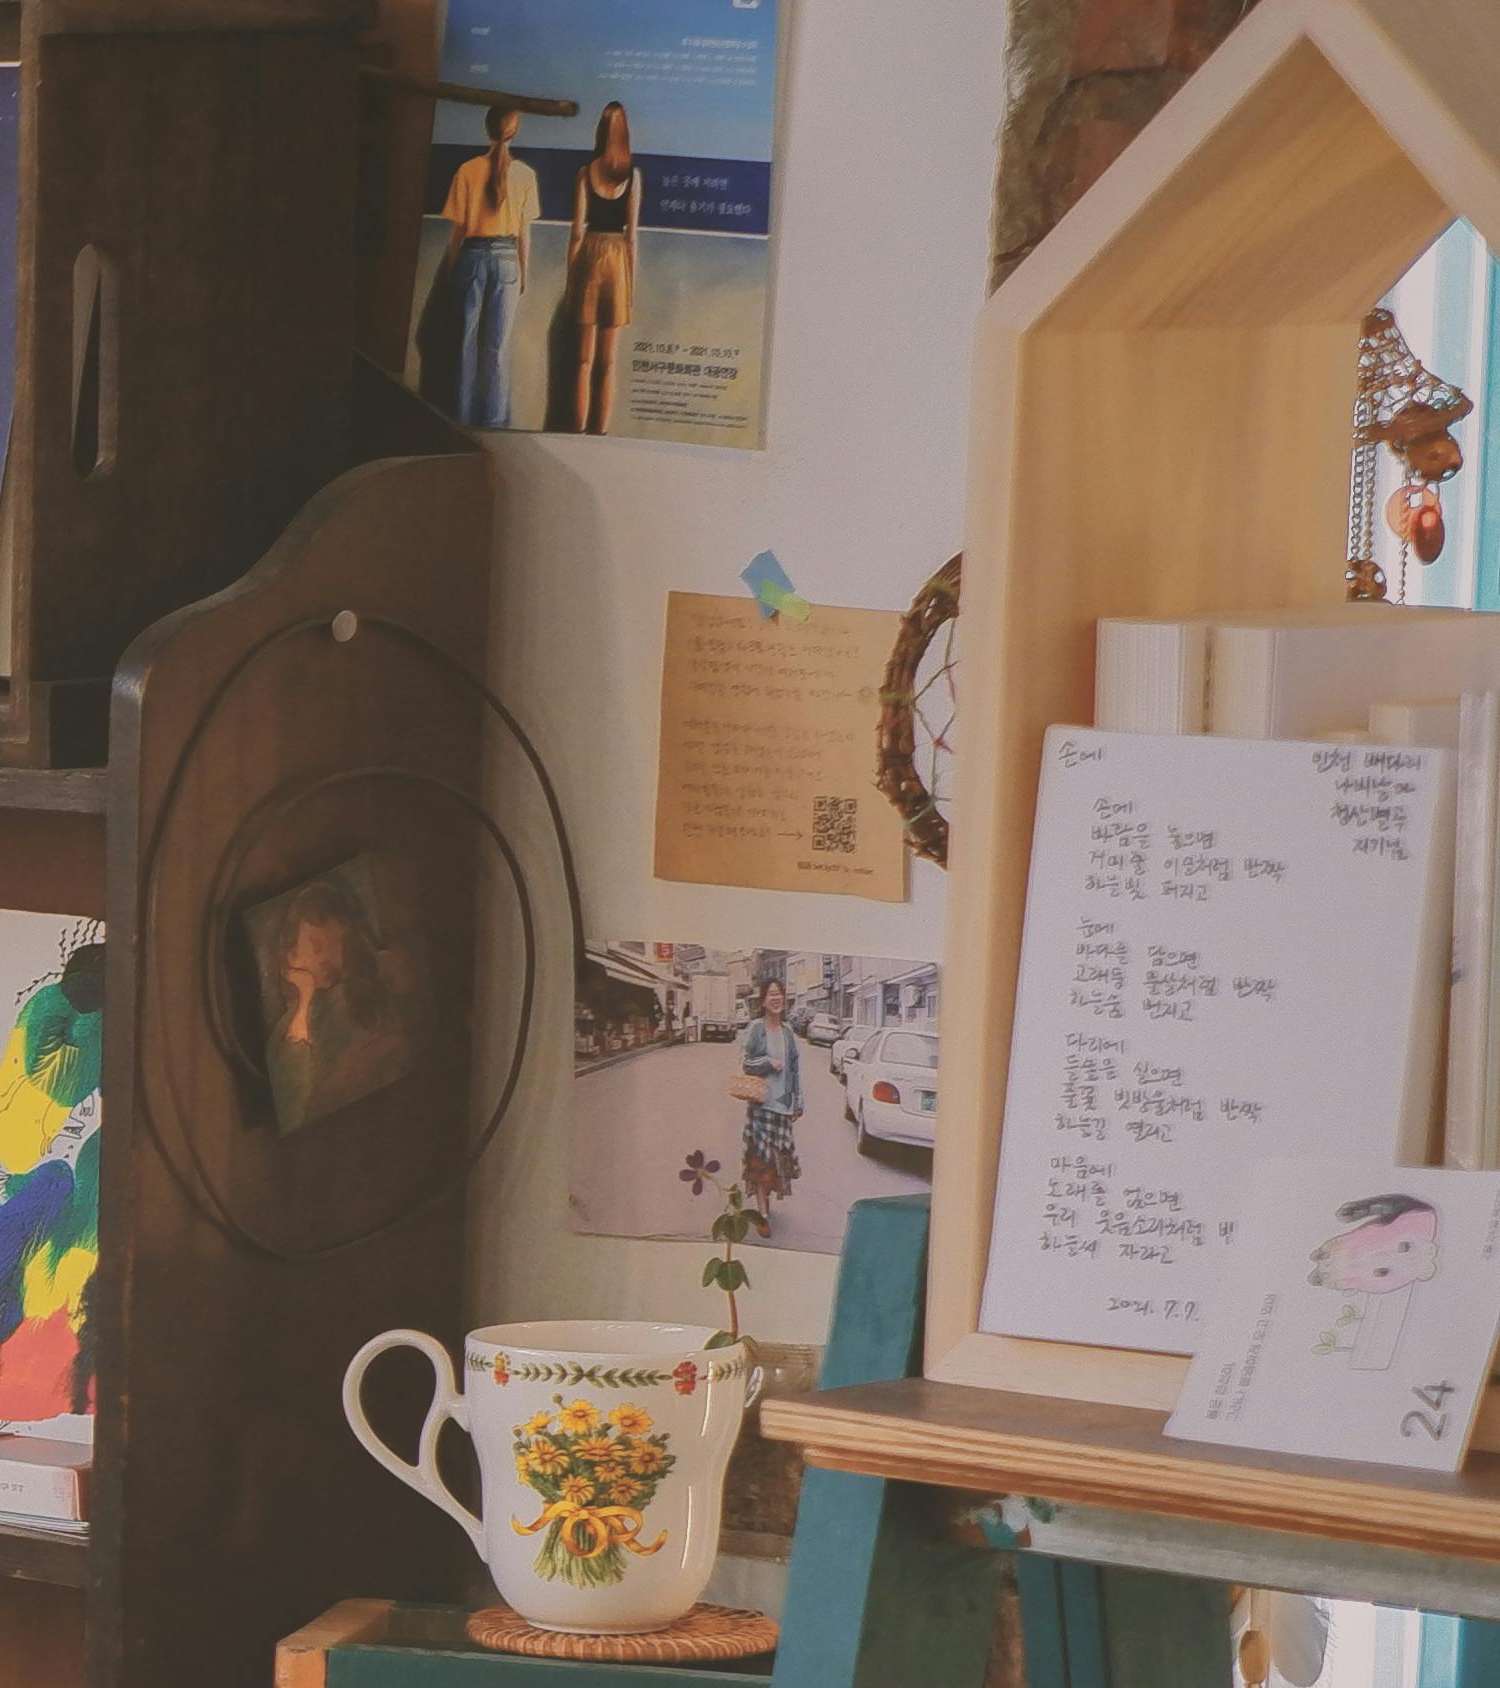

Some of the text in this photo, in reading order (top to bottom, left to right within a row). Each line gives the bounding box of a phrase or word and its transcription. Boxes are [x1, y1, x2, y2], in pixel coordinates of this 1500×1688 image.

[1091, 823, 1149, 849] 바람을
[1051, 1156, 1114, 1179] 마음에
[1401, 1381, 1455, 1441] 24
